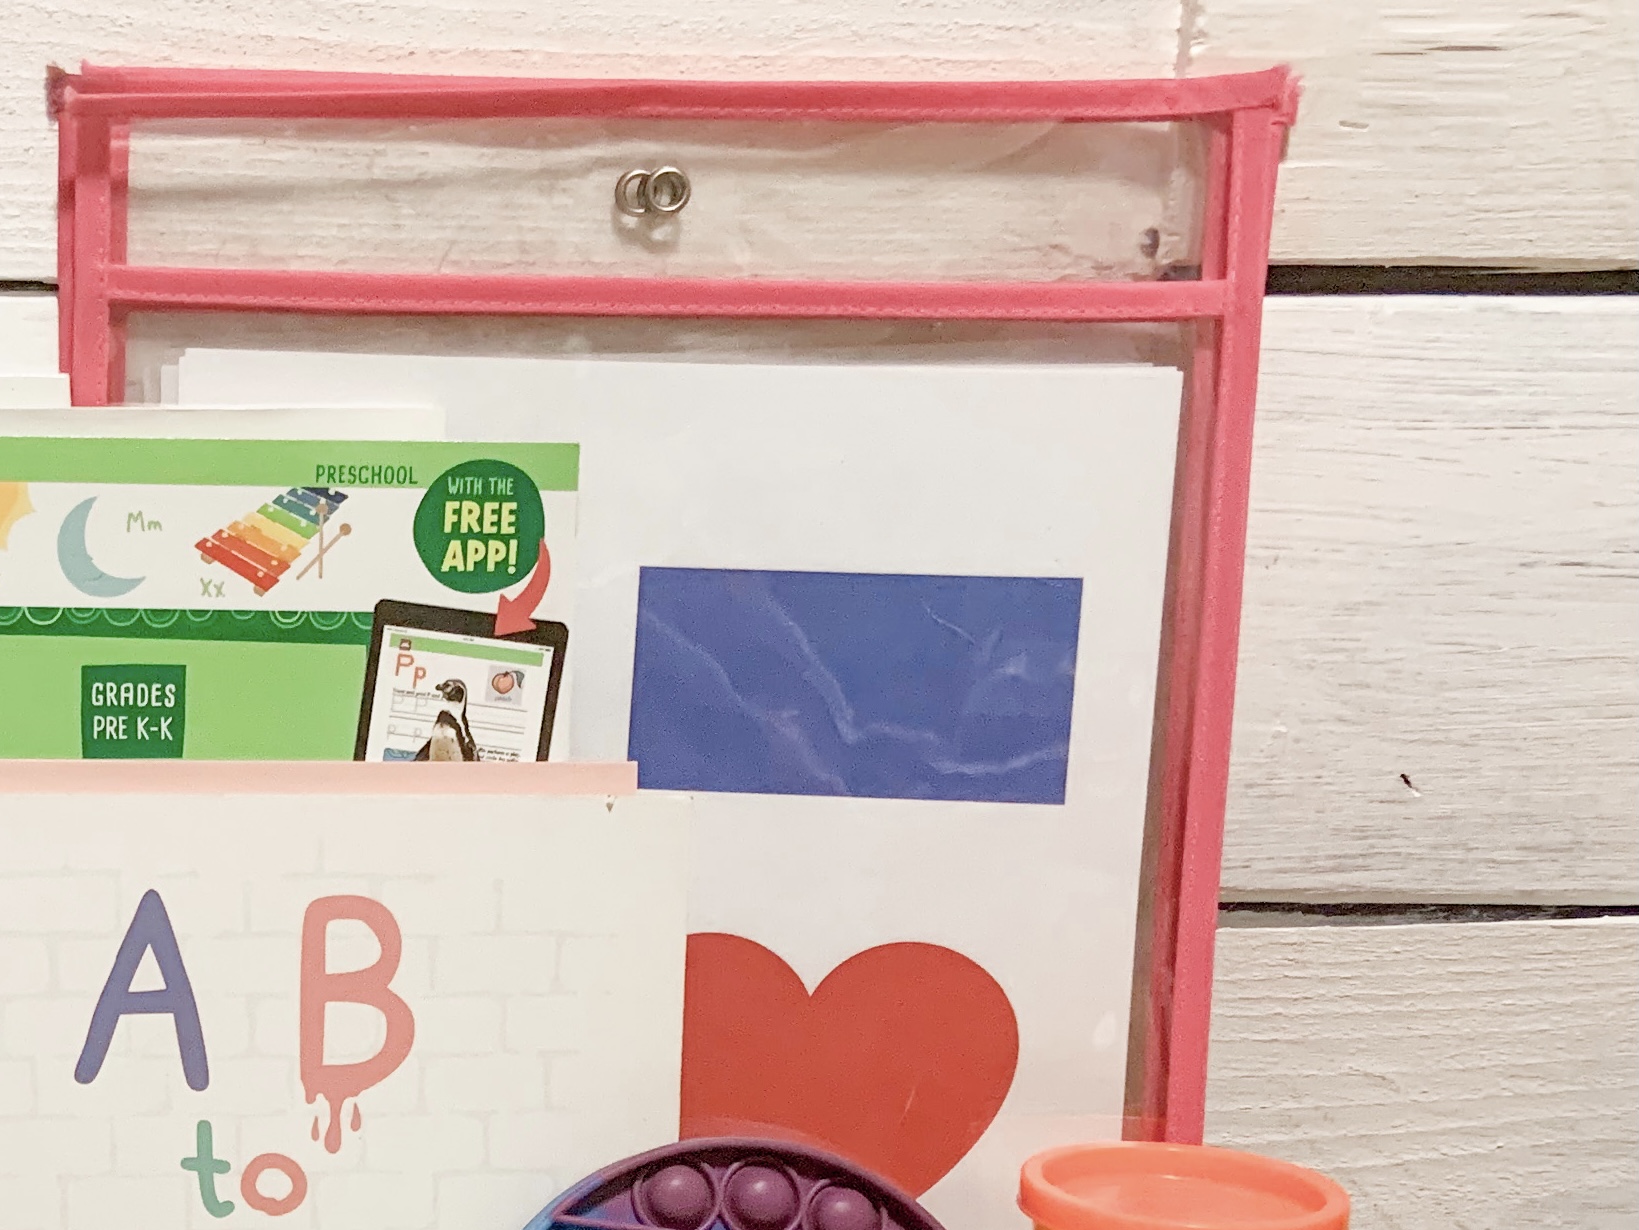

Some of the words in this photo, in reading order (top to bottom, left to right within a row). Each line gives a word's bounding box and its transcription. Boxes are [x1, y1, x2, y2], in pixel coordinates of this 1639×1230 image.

[315, 465, 419, 485] PRESCHOOL
[448, 477, 482, 495] WITH
[489, 477, 514, 496] THE
[126, 511, 163, 534] Mm
[442, 501, 517, 535] FREE
[441, 541, 518, 574] APP!
[200, 577, 226, 599] Xx
[91, 682, 176, 708] GRADES
[92, 717, 128, 740] PRE
[136, 717, 174, 742] K-K
[74, 888, 210, 1092] A
[300, 894, 416, 1128] B
[181, 1120, 308, 1219] to
